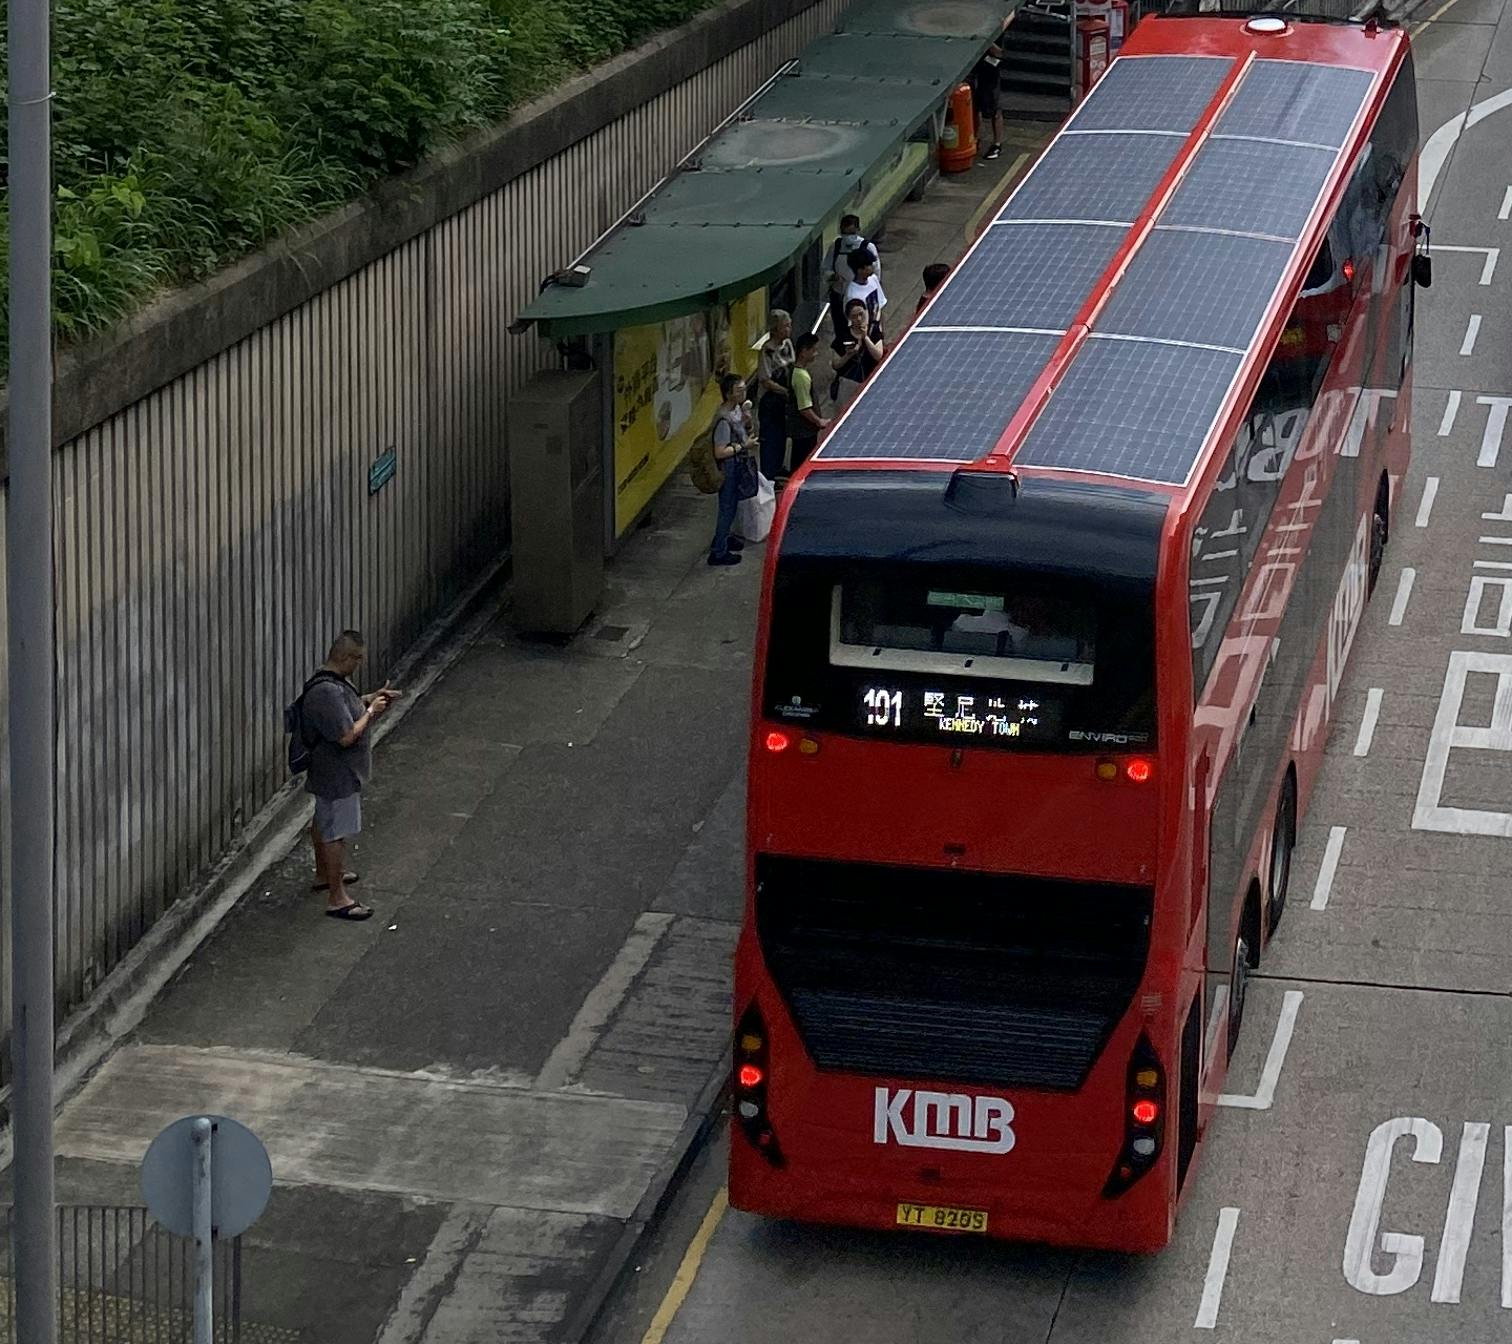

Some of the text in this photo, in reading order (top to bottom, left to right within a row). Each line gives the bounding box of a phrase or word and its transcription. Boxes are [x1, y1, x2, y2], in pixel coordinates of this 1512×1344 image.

[863, 688, 903, 727] 101
[938, 718, 1020, 737] KENNEDY TOWN
[873, 1087, 1017, 1155] KMB
[902, 1204, 925, 1224] YT
